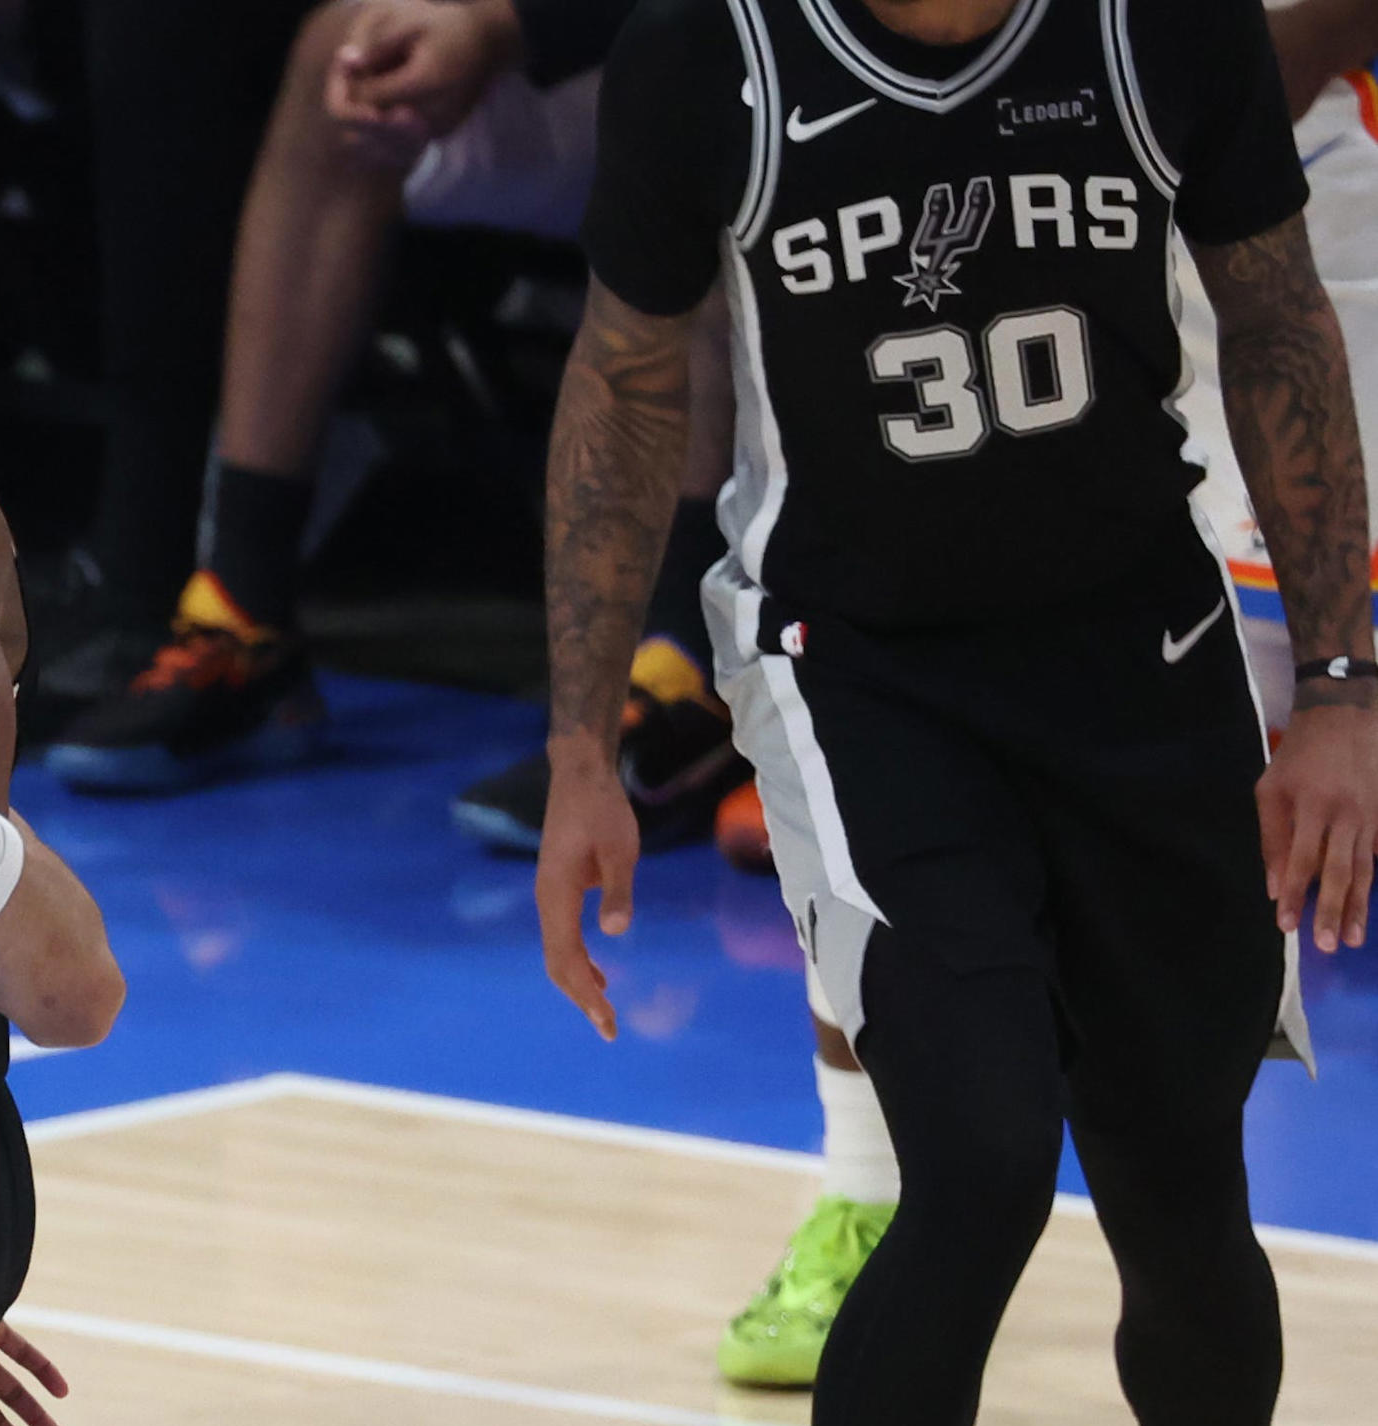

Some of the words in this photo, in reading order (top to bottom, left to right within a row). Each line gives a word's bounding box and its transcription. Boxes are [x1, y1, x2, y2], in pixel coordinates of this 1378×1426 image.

[1010, 100, 1085, 125] LEDGER
[772, 173, 1139, 313] SPURS
[865, 304, 1097, 464] 30
